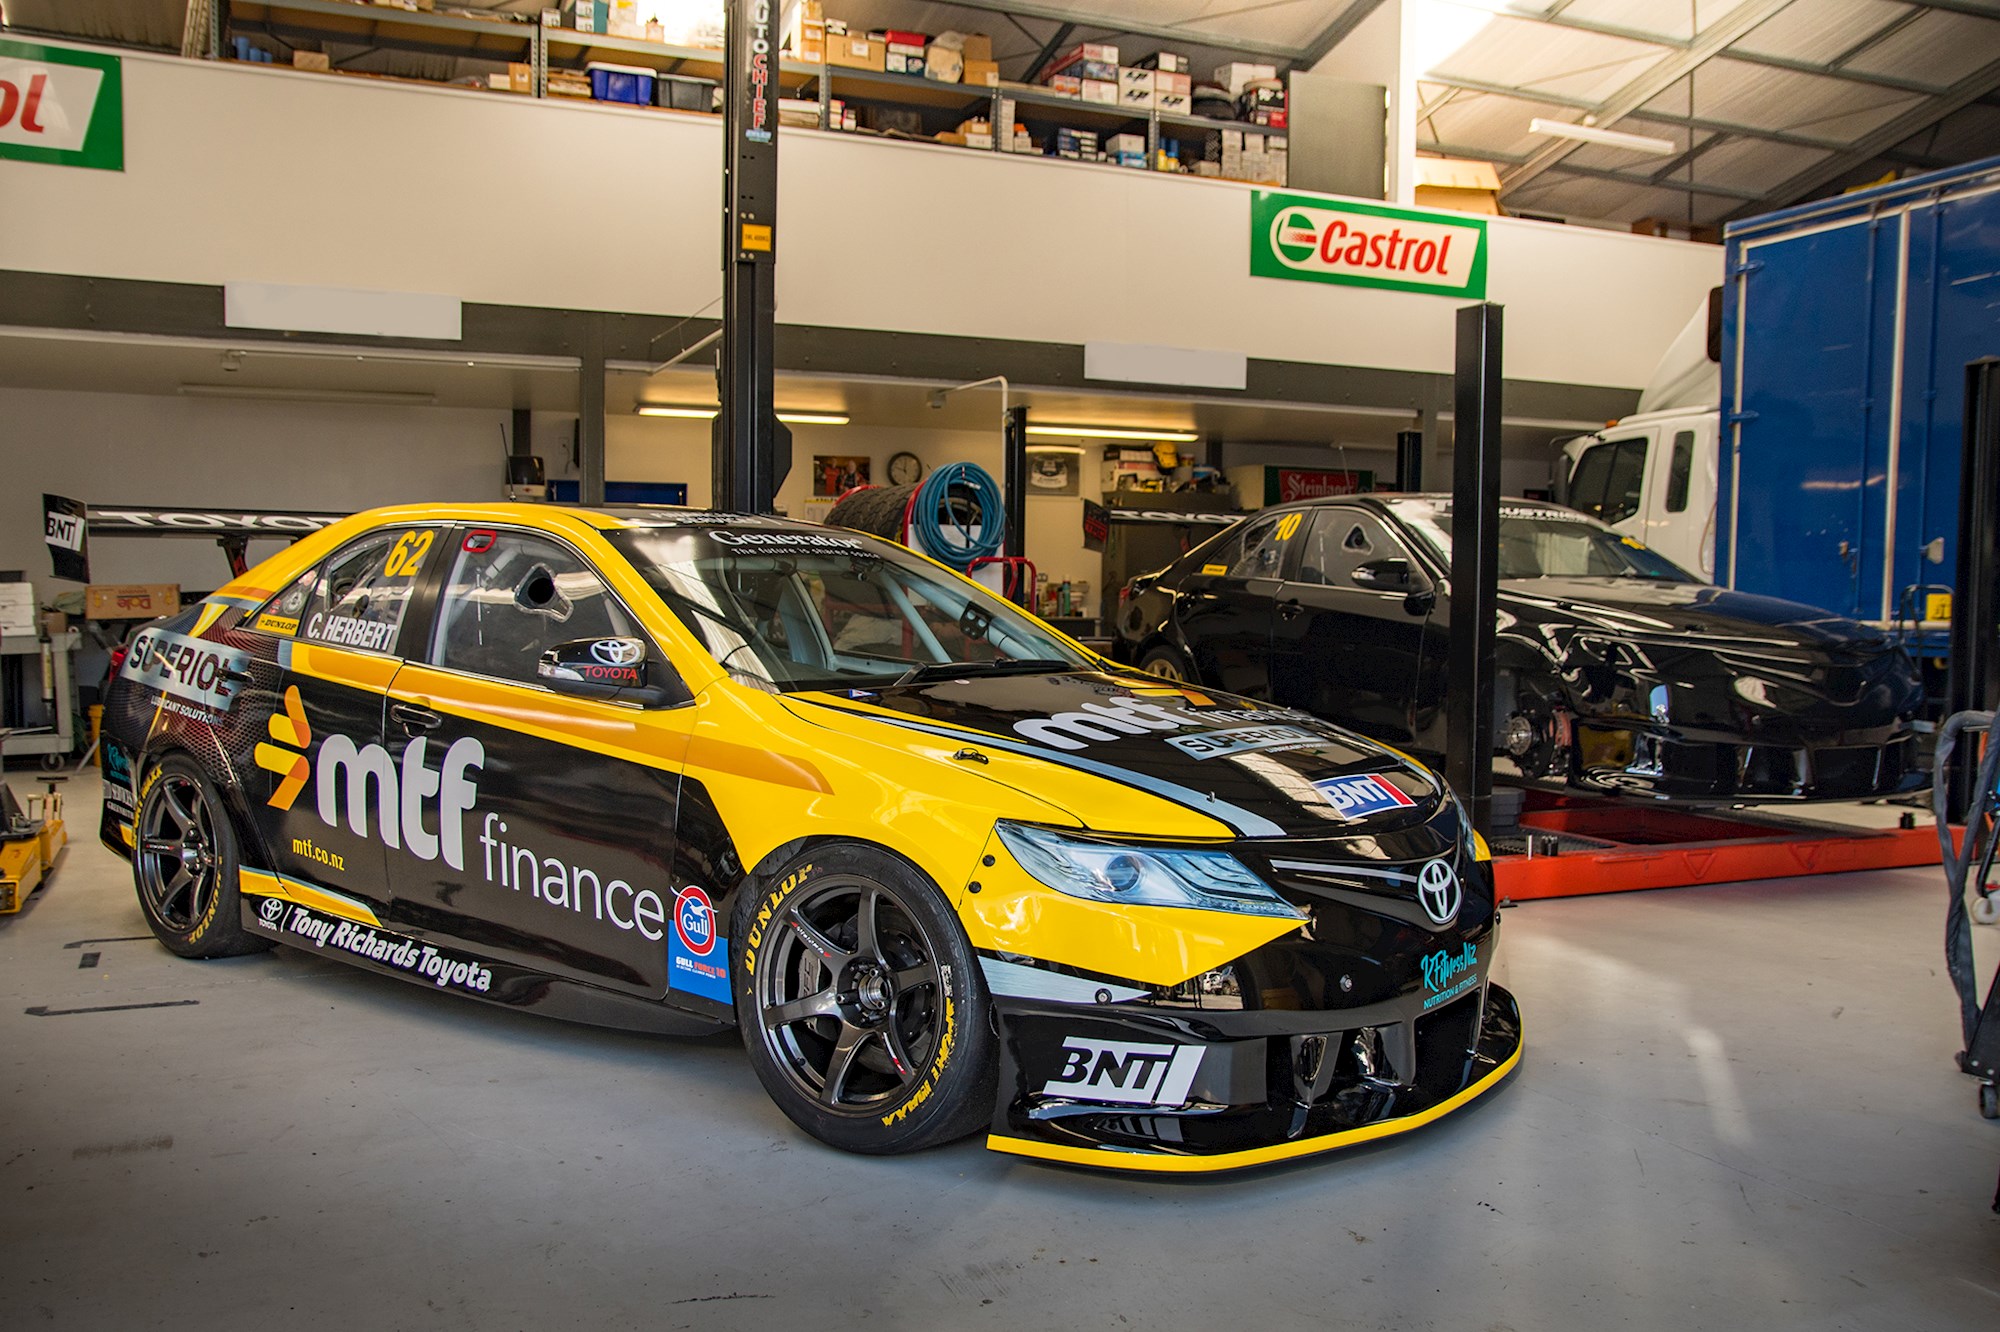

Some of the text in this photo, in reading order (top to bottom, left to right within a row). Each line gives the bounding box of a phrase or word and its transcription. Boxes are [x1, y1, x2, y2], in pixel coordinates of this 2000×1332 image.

[1320, 220, 1452, 275] Castrol
[1275, 513, 1303, 541] 10
[384, 530, 434, 577] 62
[731, 547, 757, 556] The
[758, 547, 797, 555] future
[117, 597, 152, 611] Dole
[264, 619, 297, 631] DUNLOP
[307, 612, 397, 650] C. HERBERT
[129, 635, 233, 697] SUPERIOL
[583, 665, 638, 680] TOYOTA
[1012, 696, 1203, 750] mtf
[316, 734, 485, 871] mtf
[1317, 779, 1389, 810] BNT
[293, 839, 345, 871] mtf.co.nz
[479, 812, 665, 941] finance
[683, 912, 709, 937] Gull
[289, 907, 493, 992] Tony Richards Toyota
[676, 956, 693, 969] GULL
[1423, 986, 1456, 1010] NUTRITION
